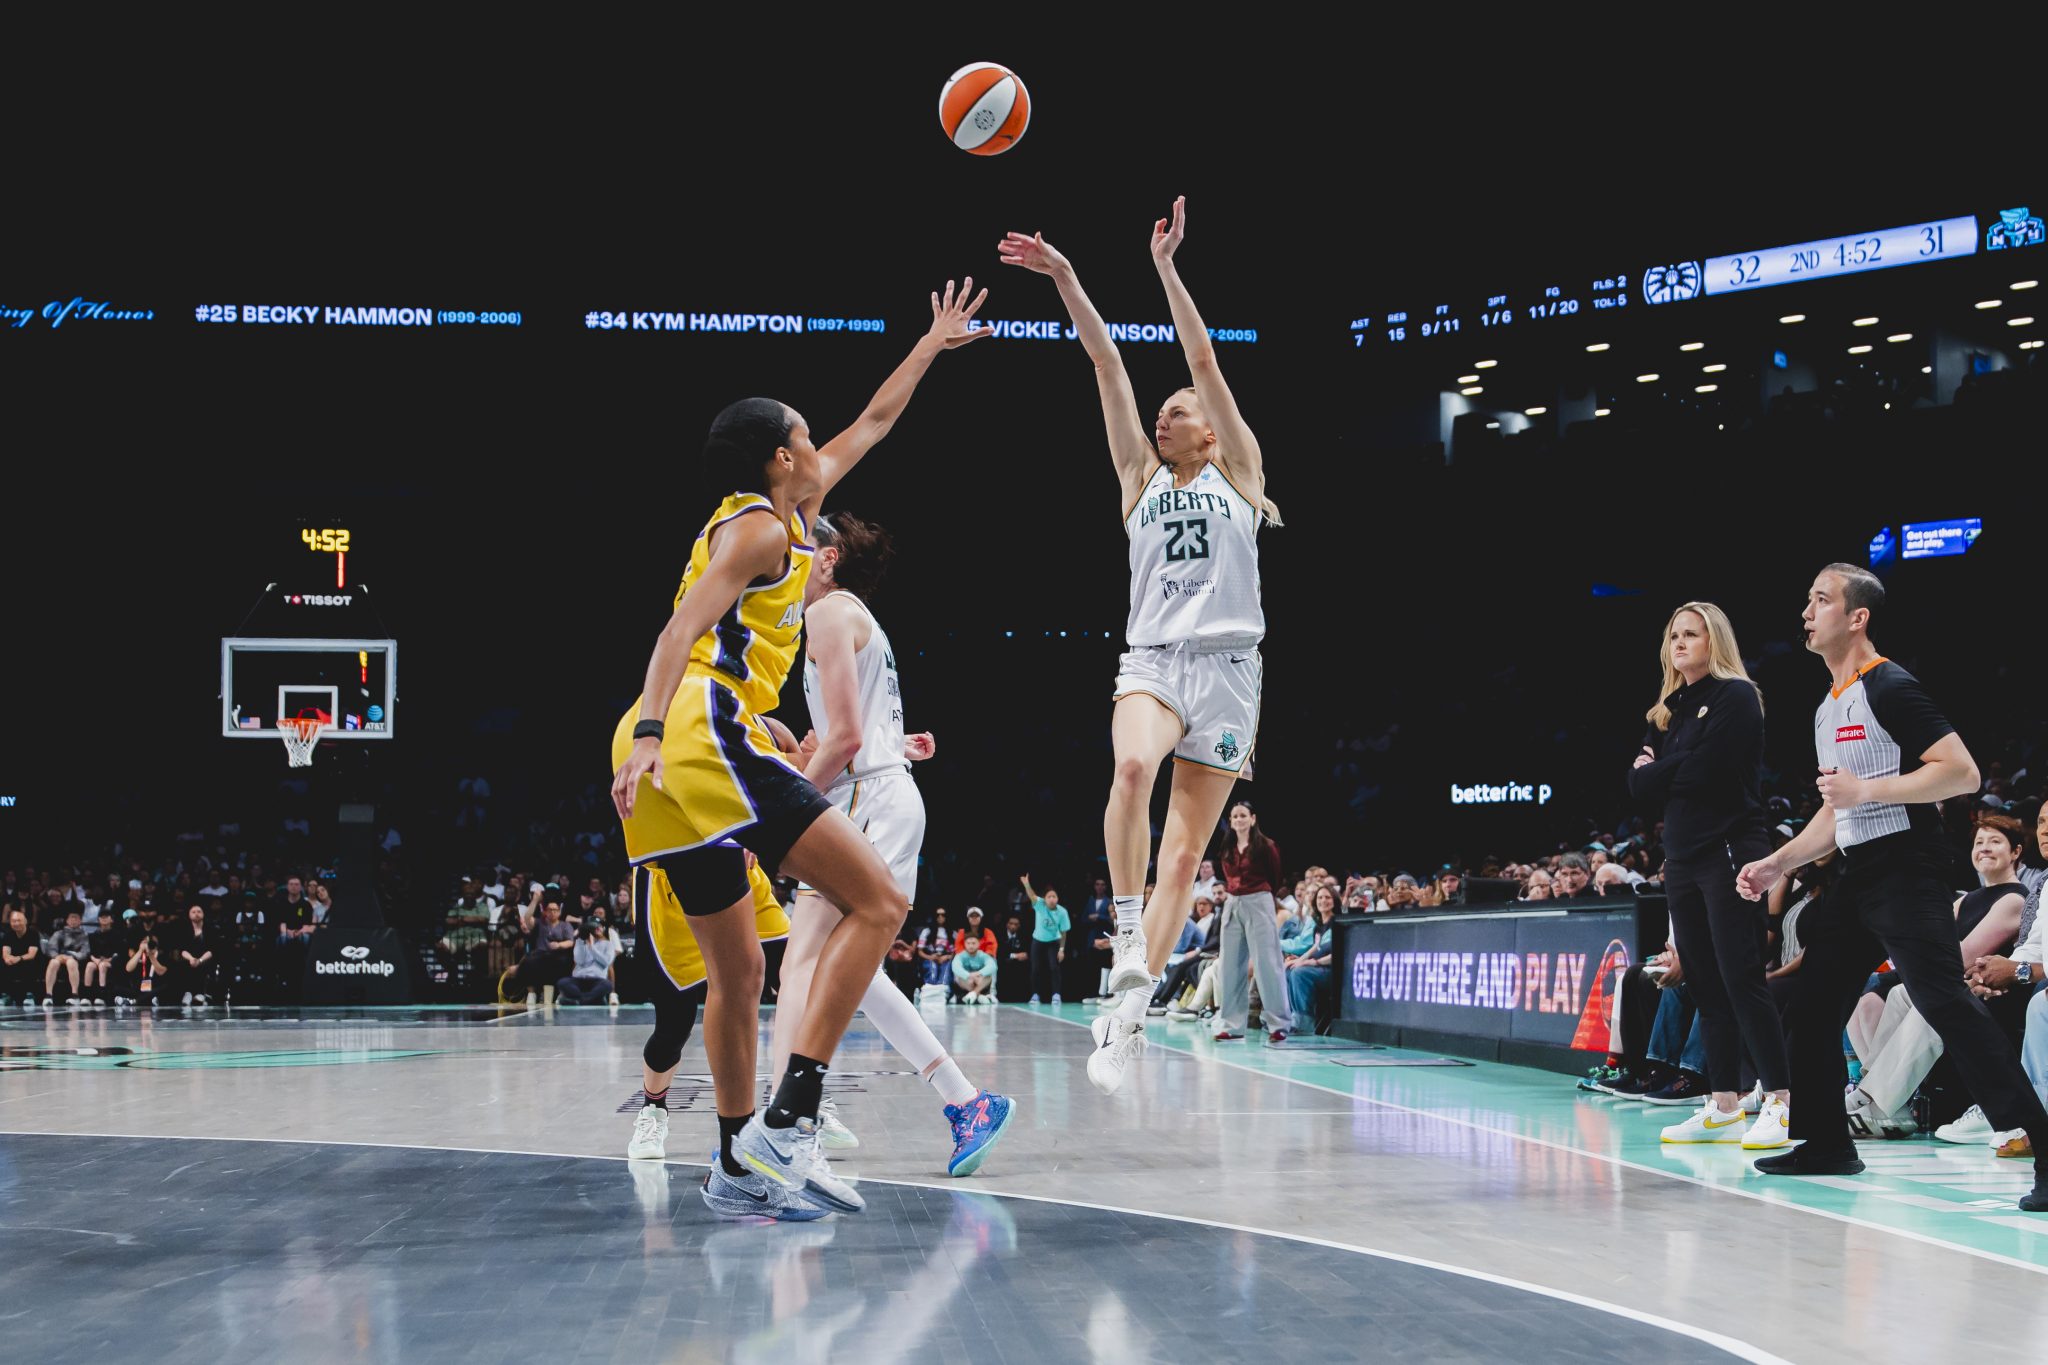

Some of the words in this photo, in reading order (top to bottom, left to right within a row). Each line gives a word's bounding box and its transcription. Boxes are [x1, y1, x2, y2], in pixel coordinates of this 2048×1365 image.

[1729, 255, 1761, 287] 32
[1789, 250, 1820, 273] 2ND
[1833, 238, 1882, 267] 4:52
[1919, 225, 1944, 256] 31
[1593, 279, 1615, 290] FLS:
[1617, 275, 1627, 288] 2
[1545, 287, 1561, 298] FG
[1488, 295, 1507, 307] 3PT
[1593, 298, 1616, 309] TOL:
[1617, 294, 1627, 307] 5
[0, 305, 34, 328] ing
[42, 297, 82, 328] Of
[75, 301, 155, 320] Honor
[195, 305, 237, 323] #25
[243, 305, 319, 324] BECKY
[324, 307, 432, 326] HAMMON
[437, 311, 522, 325] (1999-2006)
[1436, 304, 1449, 316] FT
[585, 311, 628, 330] #34
[633, 312, 685, 331] KYM
[690, 313, 802, 334] HAMPTON
[807, 317, 885, 333] (1997-1999)
[1350, 318, 1370, 330] AST
[1387, 312, 1407, 324] REB
[1481, 310, 1512, 327] 1/6
[987, 320, 1060, 339] VICKIE
[1065, 322, 1174, 342] JNSON
[1206, 328, 1257, 343] 7-2005)
[1388, 328, 1406, 342] 15
[1421, 318, 1460, 337] 9/11
[1354, 334, 1365, 347] 7
[302, 529, 350, 551] 4:52
[1163, 518, 1209, 562] 23
[1182, 579, 1213, 588] Liberty
[302, 594, 352, 606] TISSOT
[364, 722, 385, 730] AT&T
[1836, 728, 1865, 740] Emirates
[315, 960, 394, 977] betterhelp
[1352, 952, 1380, 999] GET
[1381, 951, 1414, 1001] OUT
[1415, 951, 1473, 1006] THERE
[1474, 952, 1521, 1010] AND
[1524, 952, 1586, 1015] PLAY
